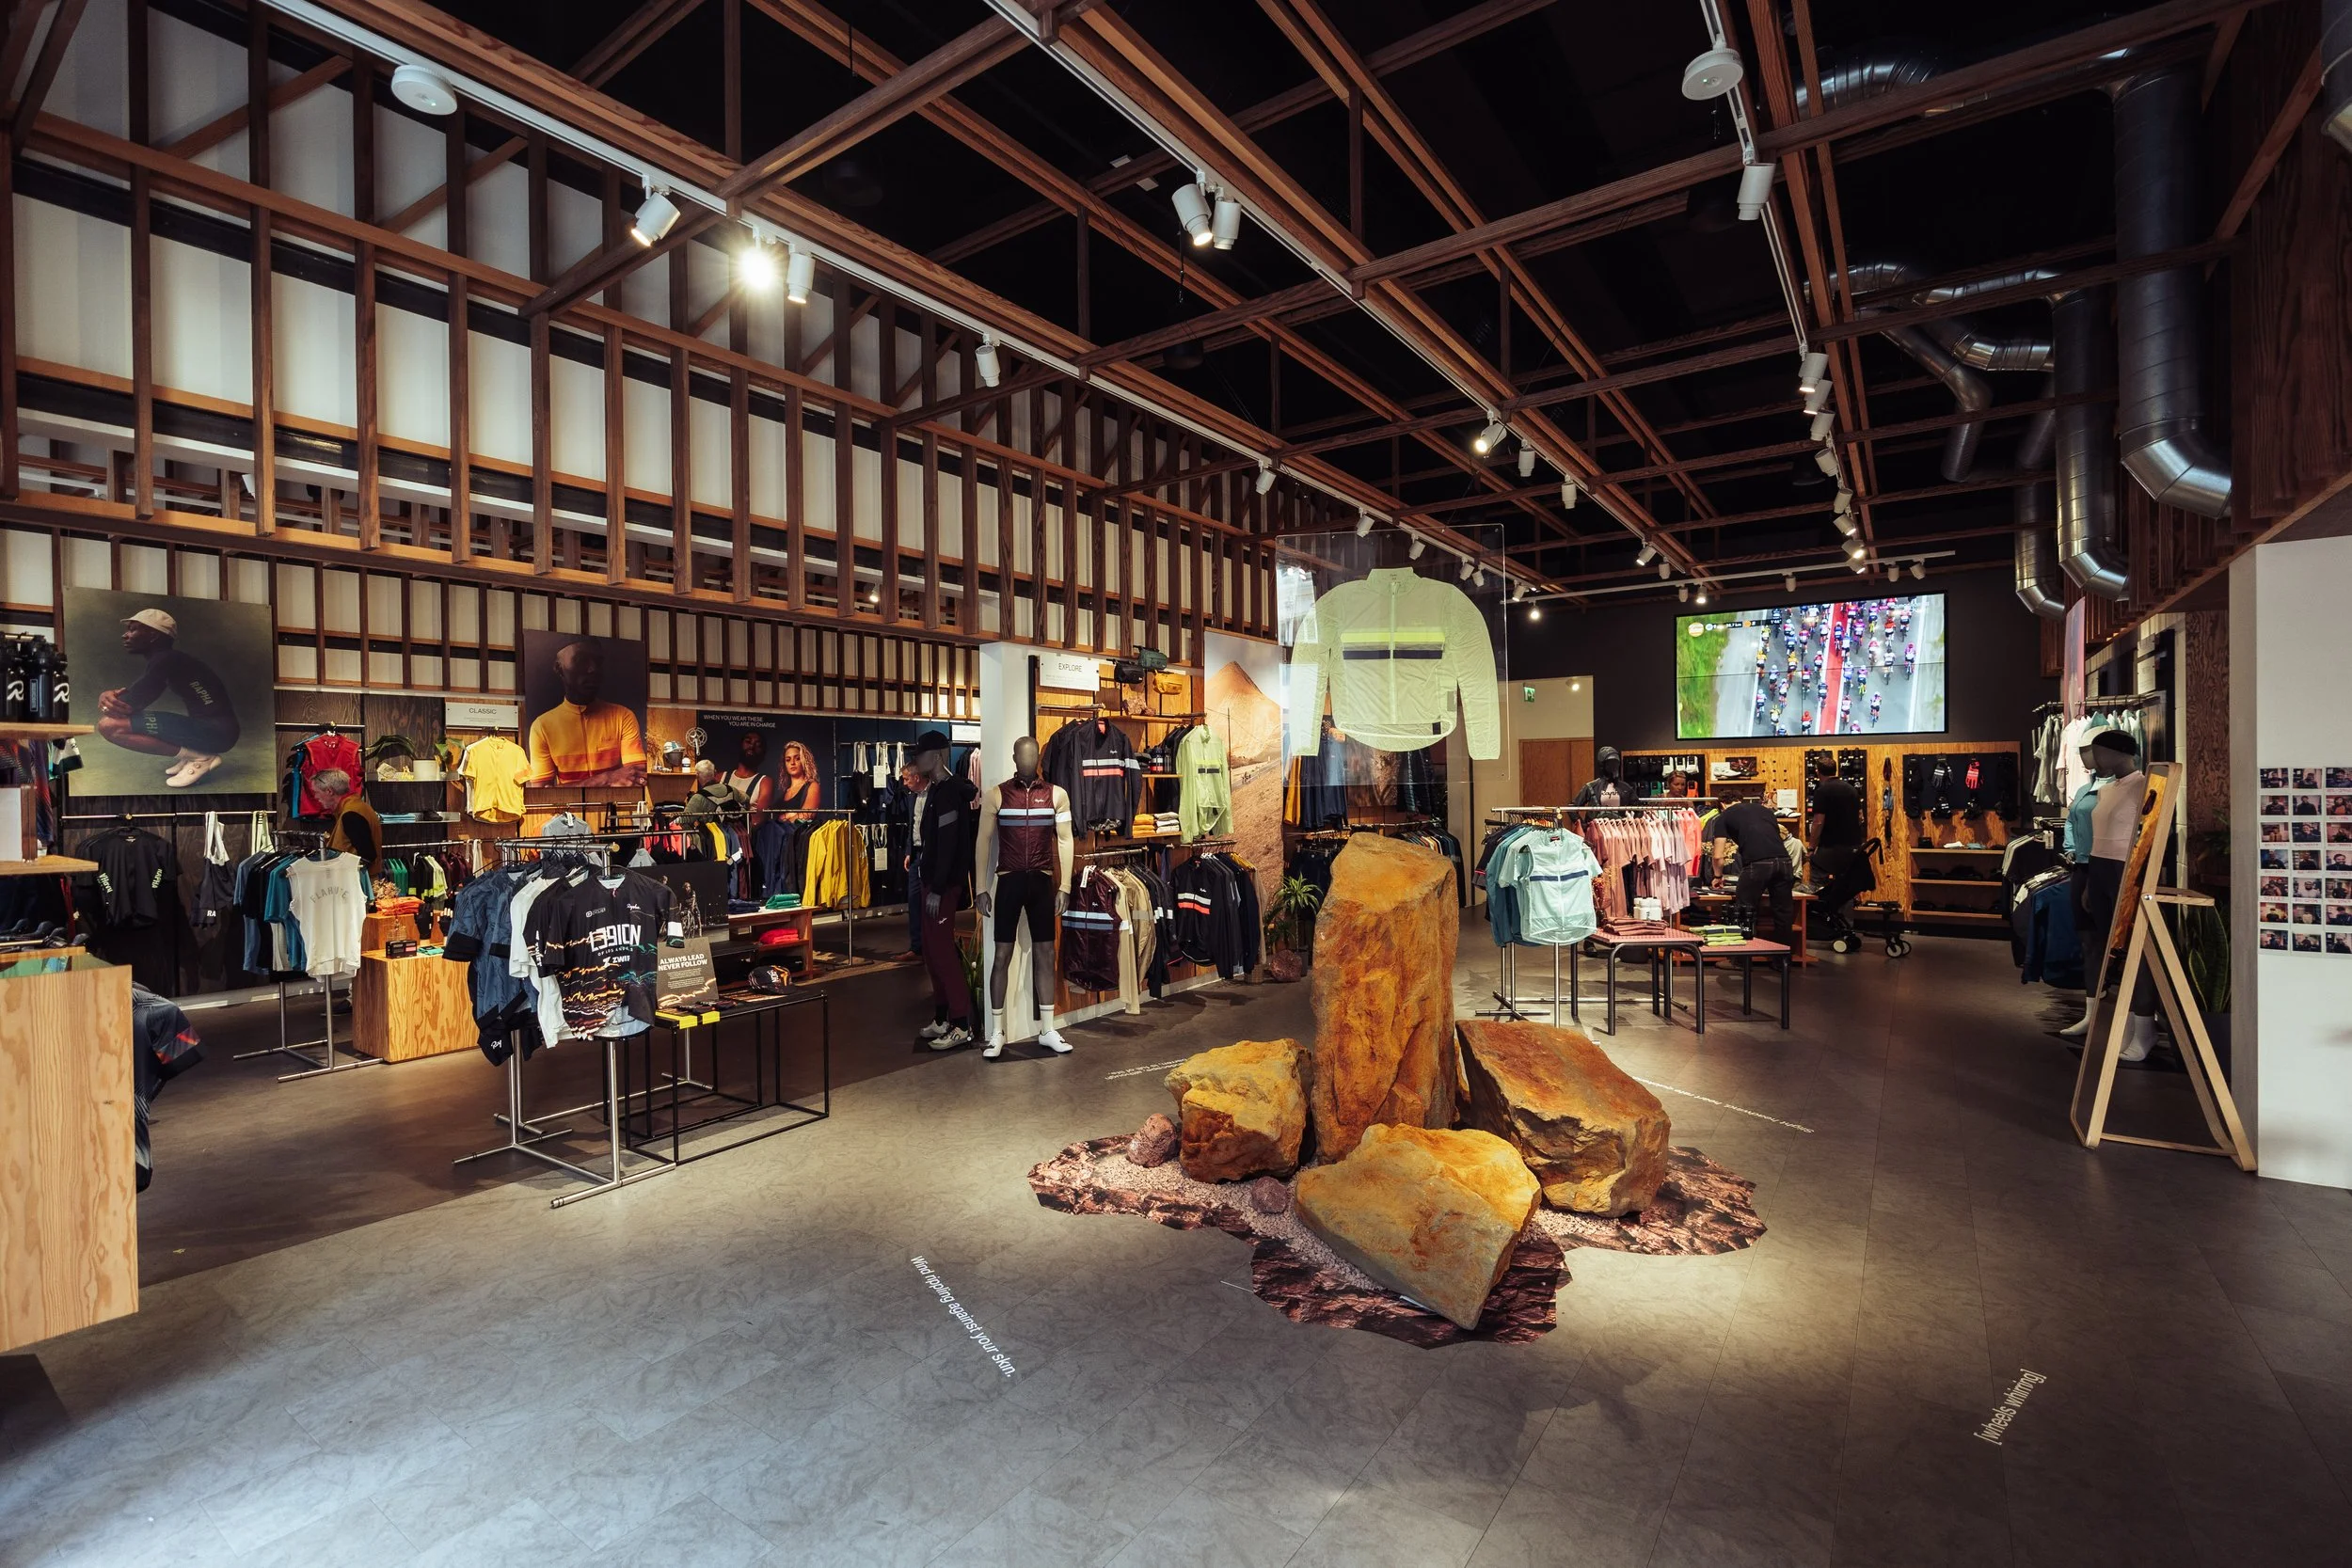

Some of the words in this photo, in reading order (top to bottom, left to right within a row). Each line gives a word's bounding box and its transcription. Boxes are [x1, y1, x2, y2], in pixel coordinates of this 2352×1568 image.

[1058, 662, 1083, 673] EXPLORE
[189, 680, 215, 706] RAPHA
[151, 868, 163, 889] RAPHA
[659, 962, 680, 972] NEVER
[680, 958, 707, 968] FOLLOW
[660, 956, 688, 965] ALWAYS
[688, 953, 705, 961] LEAD
[1694, 1095, 1723, 1105] heart
[1779, 1120, 1815, 1133] Slight
[911, 1255, 935, 1275] Wind
[925, 1272, 956, 1304] rippling
[948, 1302, 983, 1334] against
[969, 1331, 999, 1354] your
[991, 1353, 1016, 1378] skin.
[1973, 1405, 2017, 1446] [wheels
[2003, 1368, 2047, 1408] whirring]
